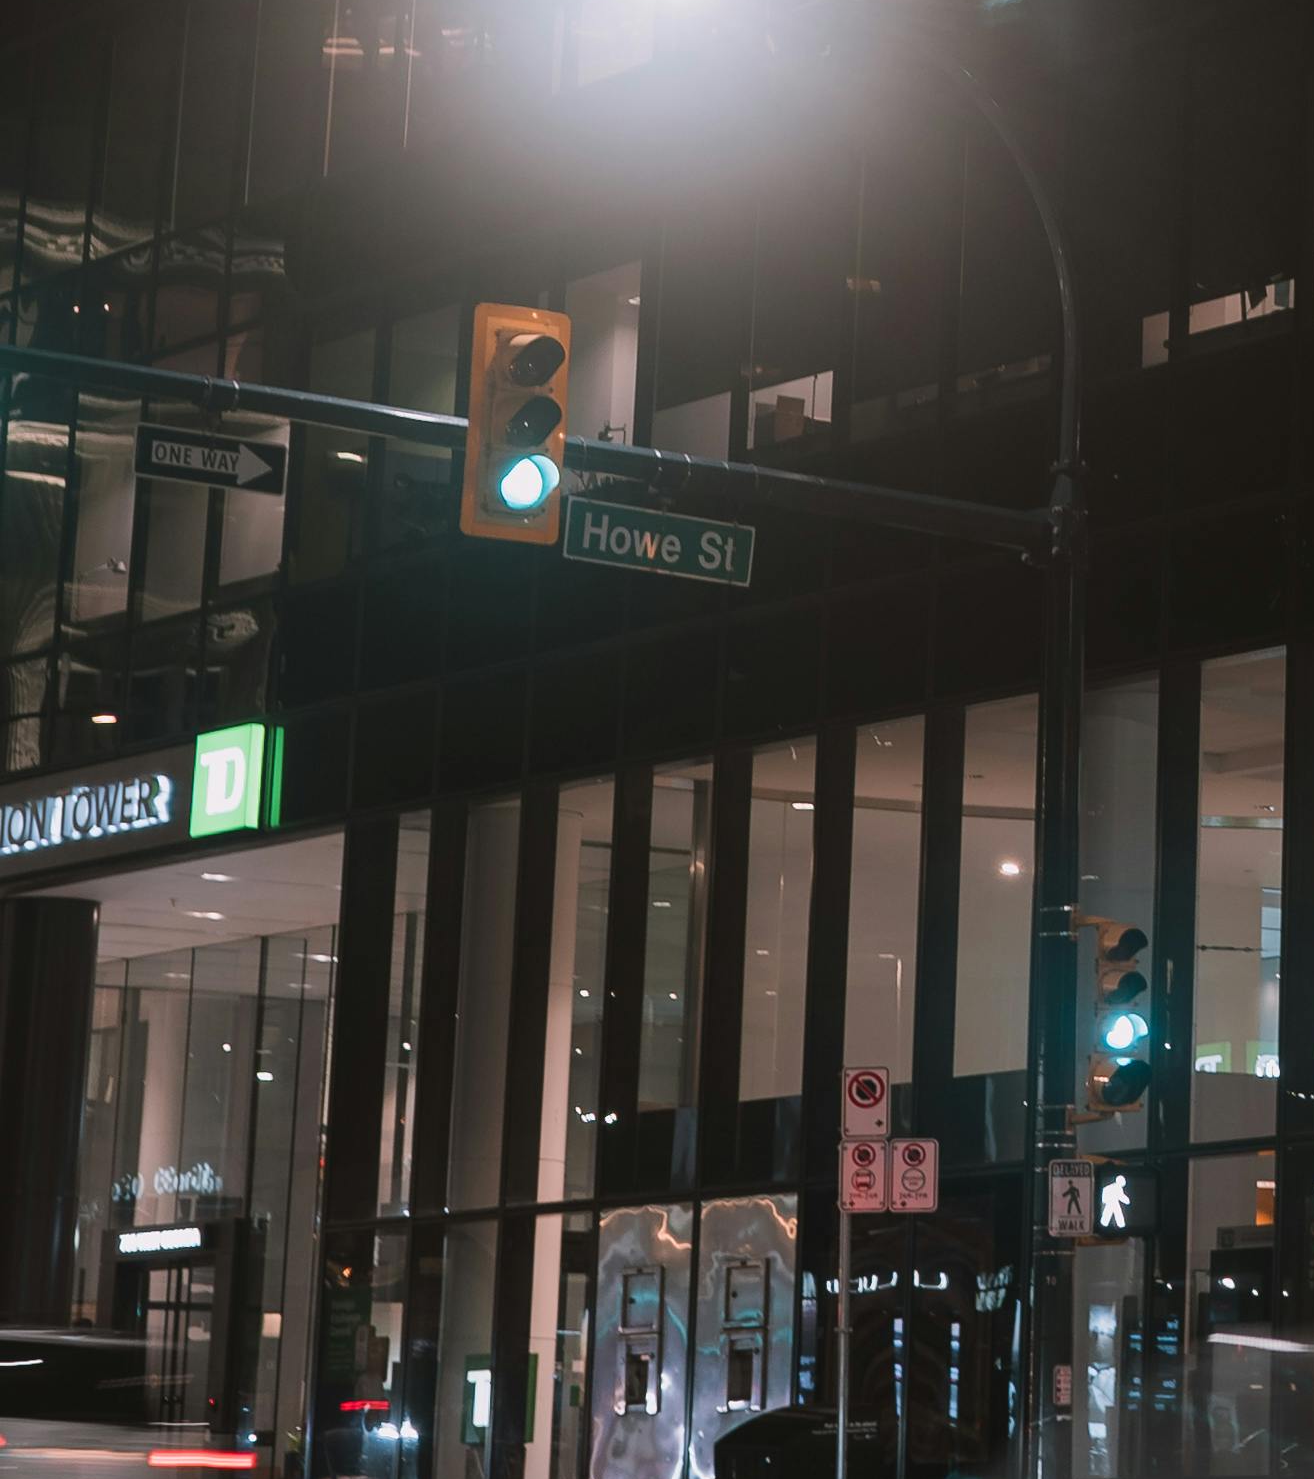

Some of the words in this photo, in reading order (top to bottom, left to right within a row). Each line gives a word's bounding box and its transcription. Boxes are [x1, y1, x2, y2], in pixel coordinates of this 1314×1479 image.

[154, 443, 192, 466] ONE
[201, 449, 240, 473] WAY
[582, 511, 682, 564] Howe
[698, 530, 737, 572] St
[200, 746, 247, 816] TD
[54, 775, 164, 839] TOWER
[1052, 1163, 1090, 1177] DELAYED
[1058, 1219, 1085, 1232] WALK
